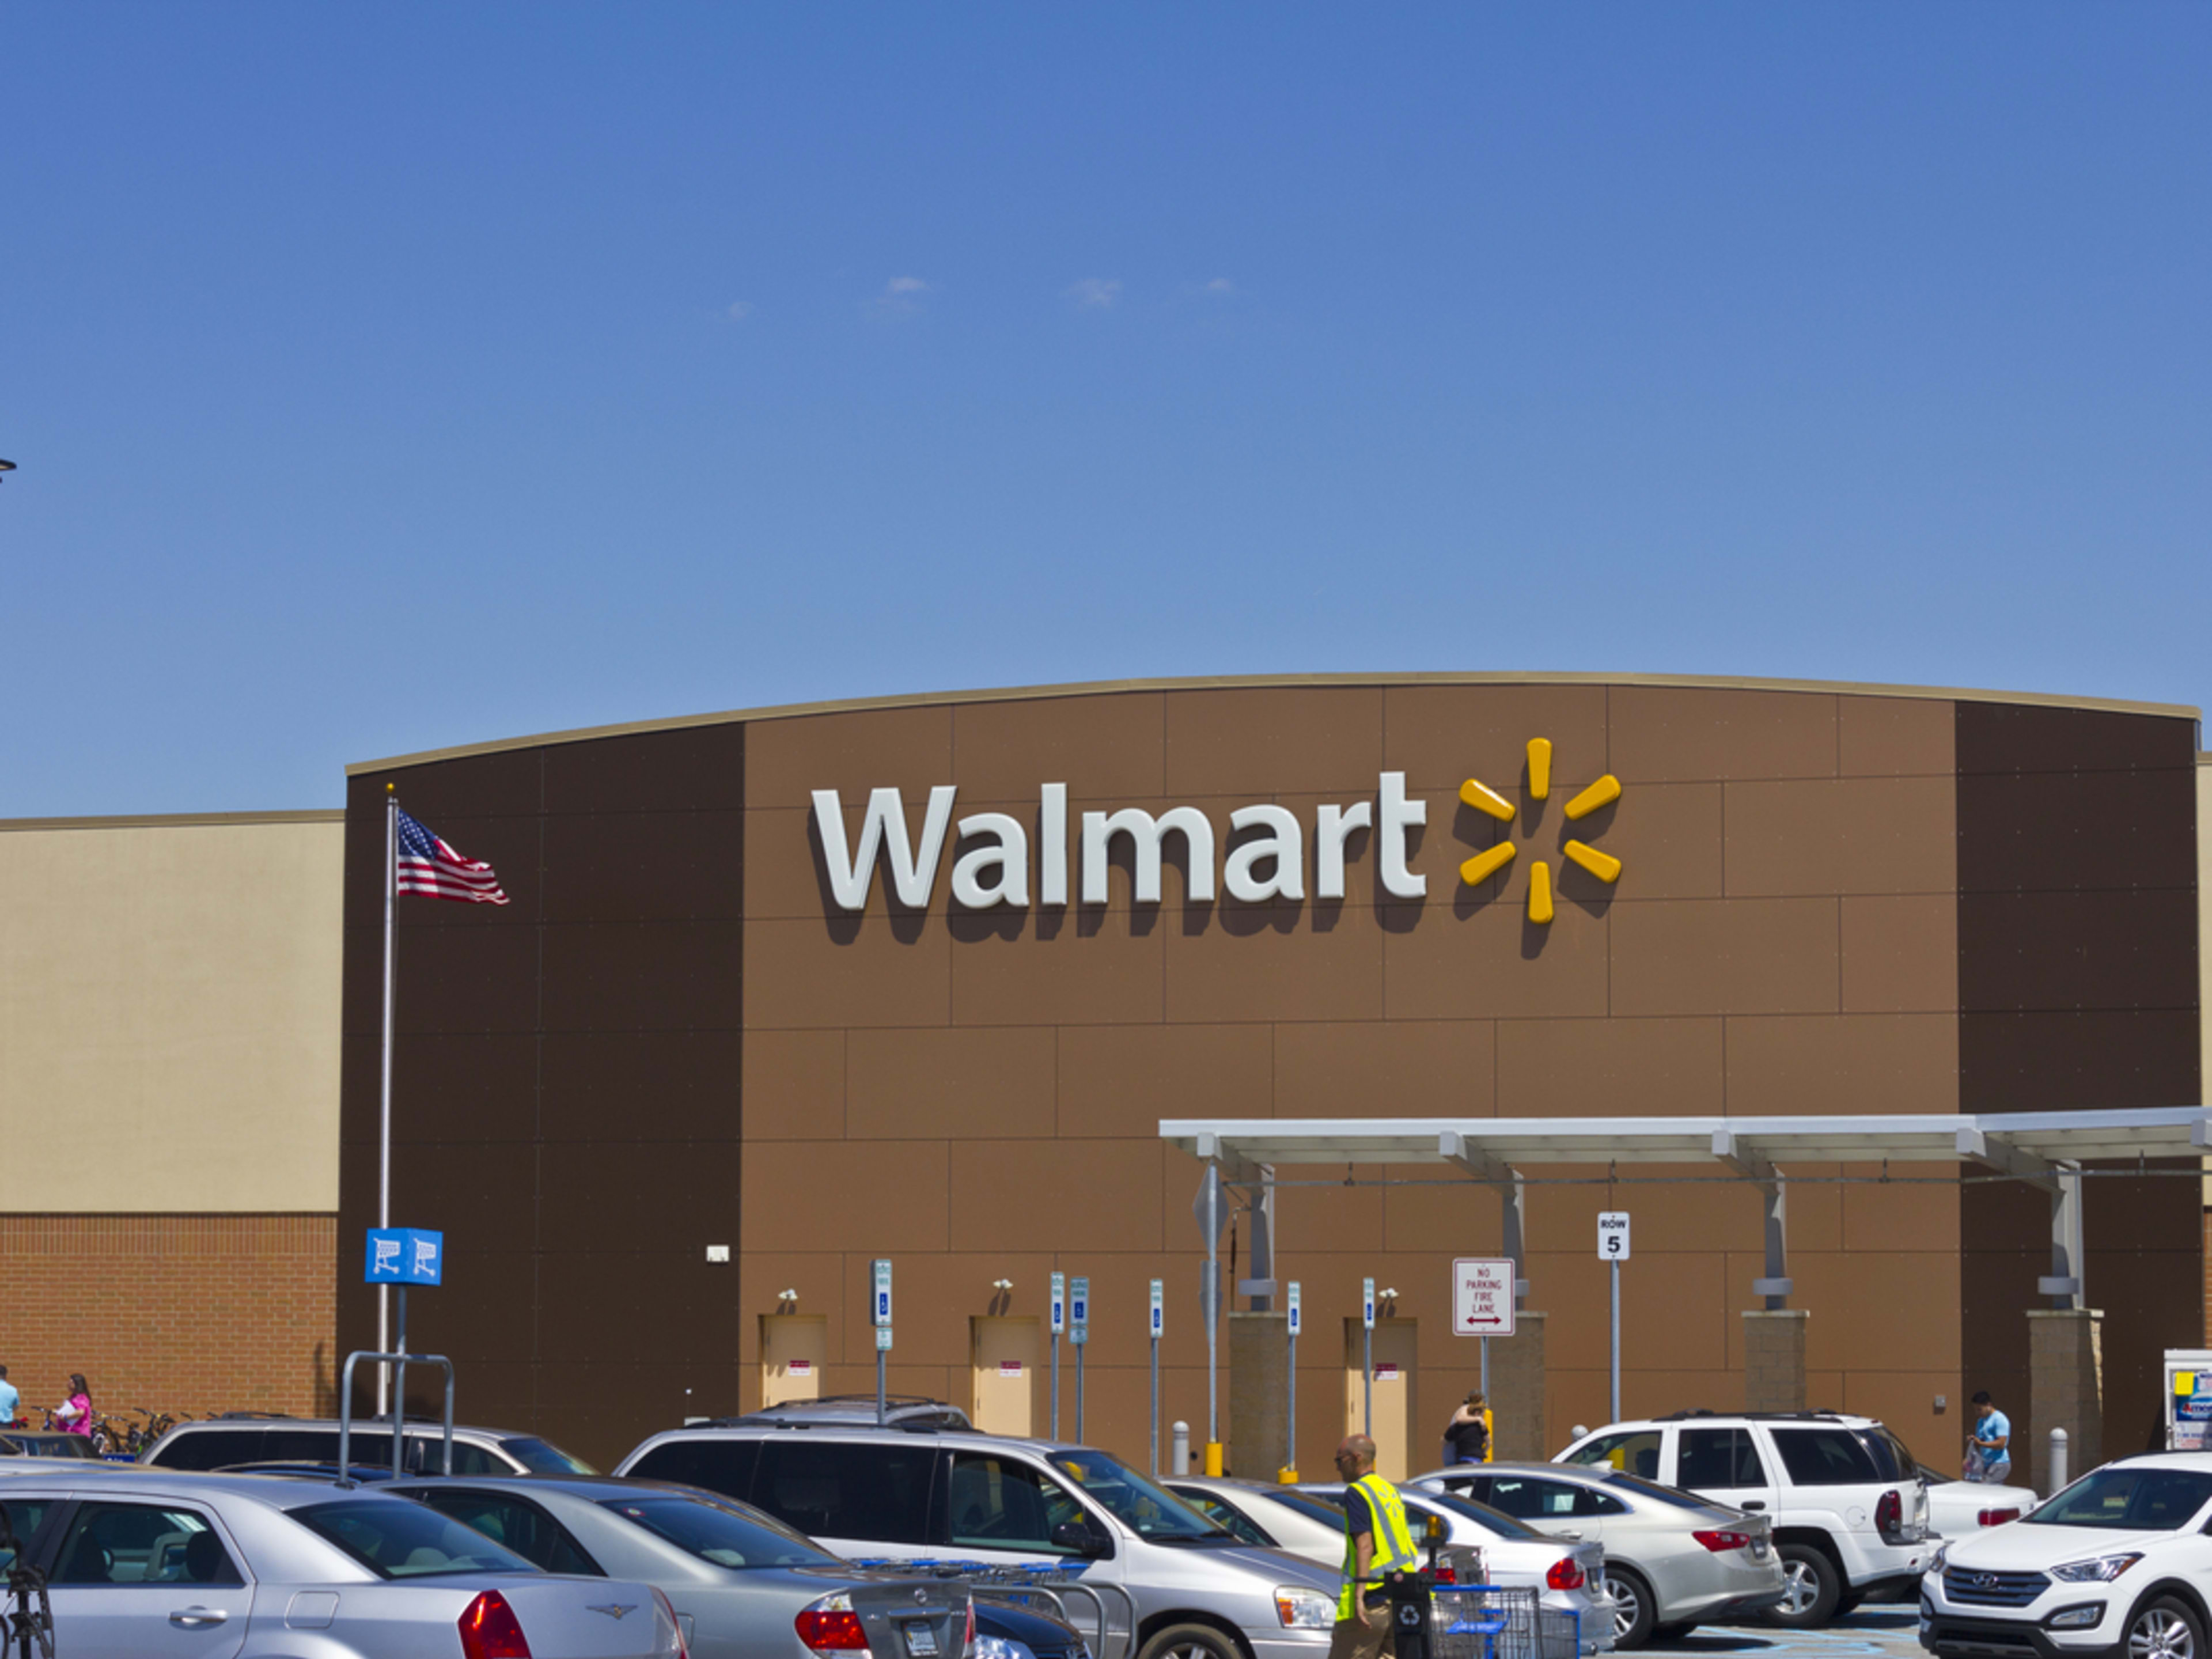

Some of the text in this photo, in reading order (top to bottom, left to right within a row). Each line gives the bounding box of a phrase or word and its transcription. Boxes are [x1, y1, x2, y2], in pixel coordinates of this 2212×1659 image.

[811, 771, 1427, 910] Walmart
[1601, 1219, 1626, 1228] ROW
[1608, 1236, 1620, 1253] 5
[1478, 1268, 1490, 1278] NO
[1466, 1279, 1502, 1290] PARKING
[1474, 1291, 1493, 1301] FIRE
[1472, 1303, 1494, 1313] LANE
